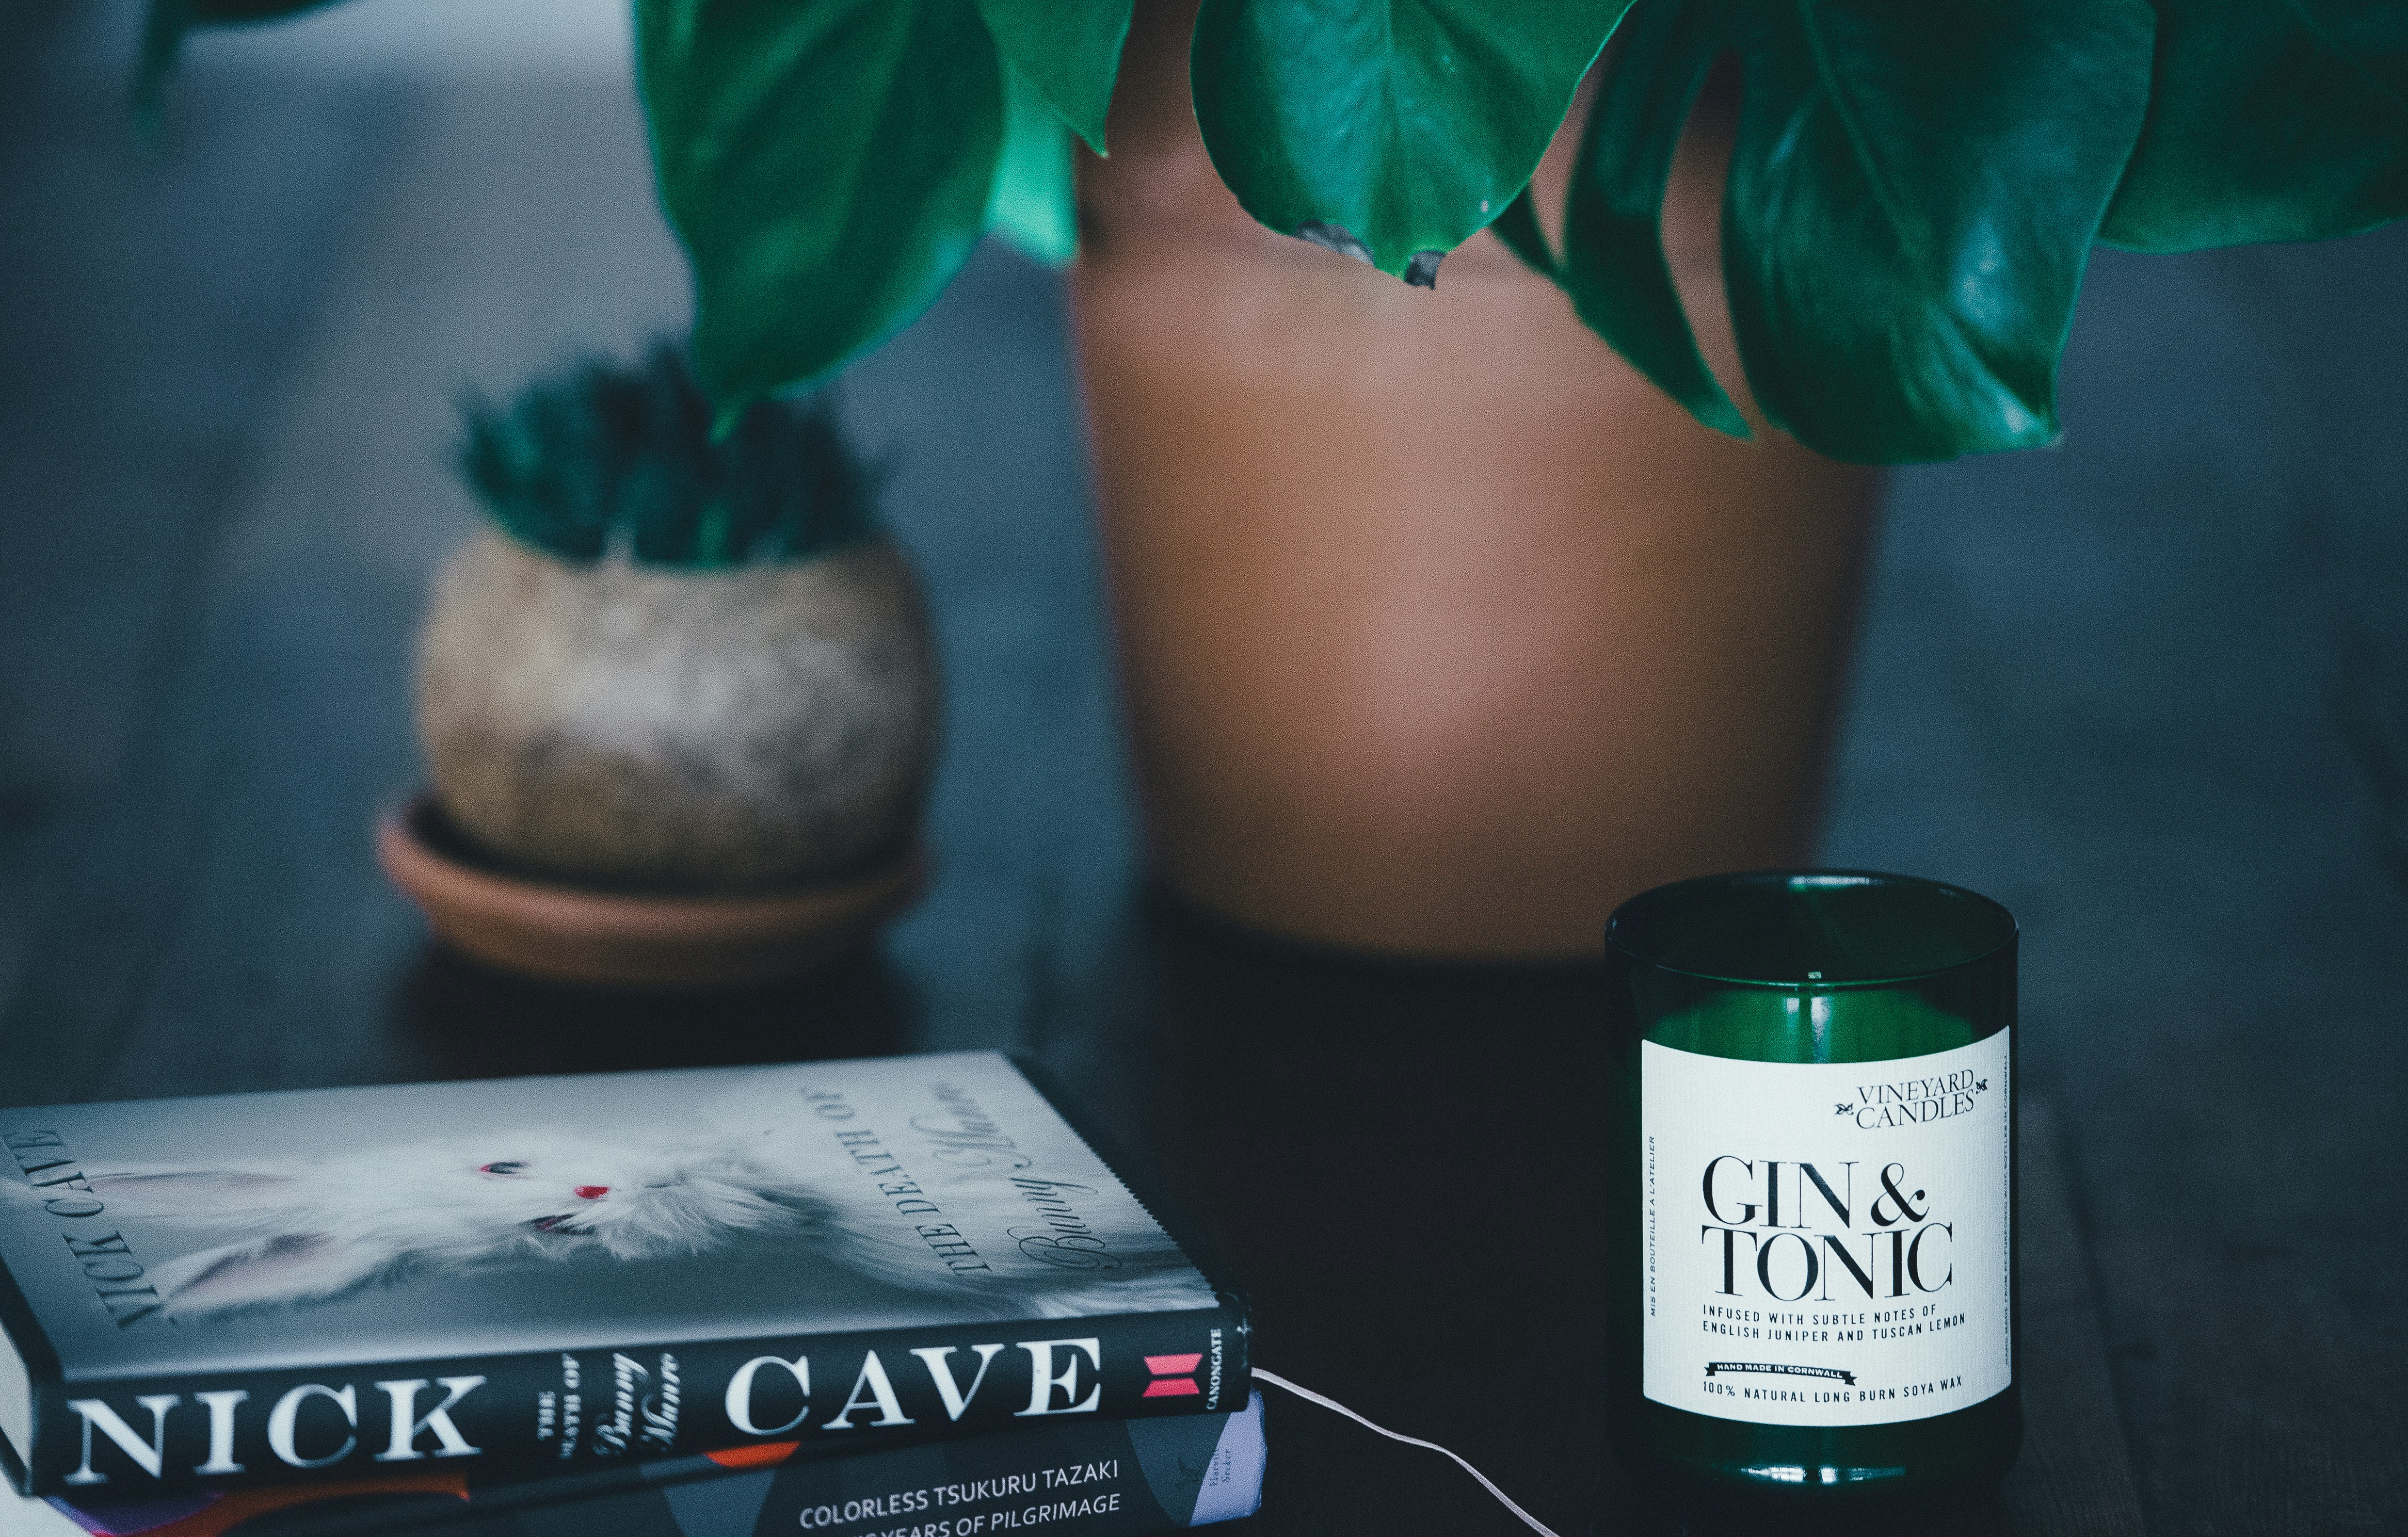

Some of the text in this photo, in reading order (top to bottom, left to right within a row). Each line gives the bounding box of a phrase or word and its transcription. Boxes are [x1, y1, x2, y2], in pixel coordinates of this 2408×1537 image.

[1857, 1069, 1974, 1104] VINEYARD
[1857, 1089, 1974, 1129] CANDLES
[4, 1130, 103, 1217] CAVE
[798, 1086, 992, 1275] THE DEATH OF
[1702, 1155, 1930, 1229] GIN &
[1007, 1176, 1121, 1269] Bunny
[1650, 1276, 1656, 1292] EN
[1702, 1222, 1953, 1301] TONIC
[1703, 1304, 1936, 1325] INFUSED WITH SUBTLE NOTES OF
[1703, 1312, 1965, 1341] ENGLISH JUNIPER AND TUSCAN LEMON
[563, 1352, 581, 1388] OF
[593, 1352, 650, 1455] Bunny
[640, 1352, 681, 1452] Munro
[724, 1337, 1102, 1436] CAVE
[1206, 1328, 1222, 1410] CANONGATE
[1703, 1375, 1962, 1403] 100% NATURAL LONG BURN SOYA WAX
[1787, 1366, 1843, 1379] CORNWALL
[63, 1375, 486, 1485] NICK
[538, 1391, 556, 1441] THE
[799, 1460, 1119, 1530] COLORLESS TSUKURU TAZAKI
[955, 1515, 986, 1536] OF
[991, 1493, 1121, 1530] PILGRIMAGE
